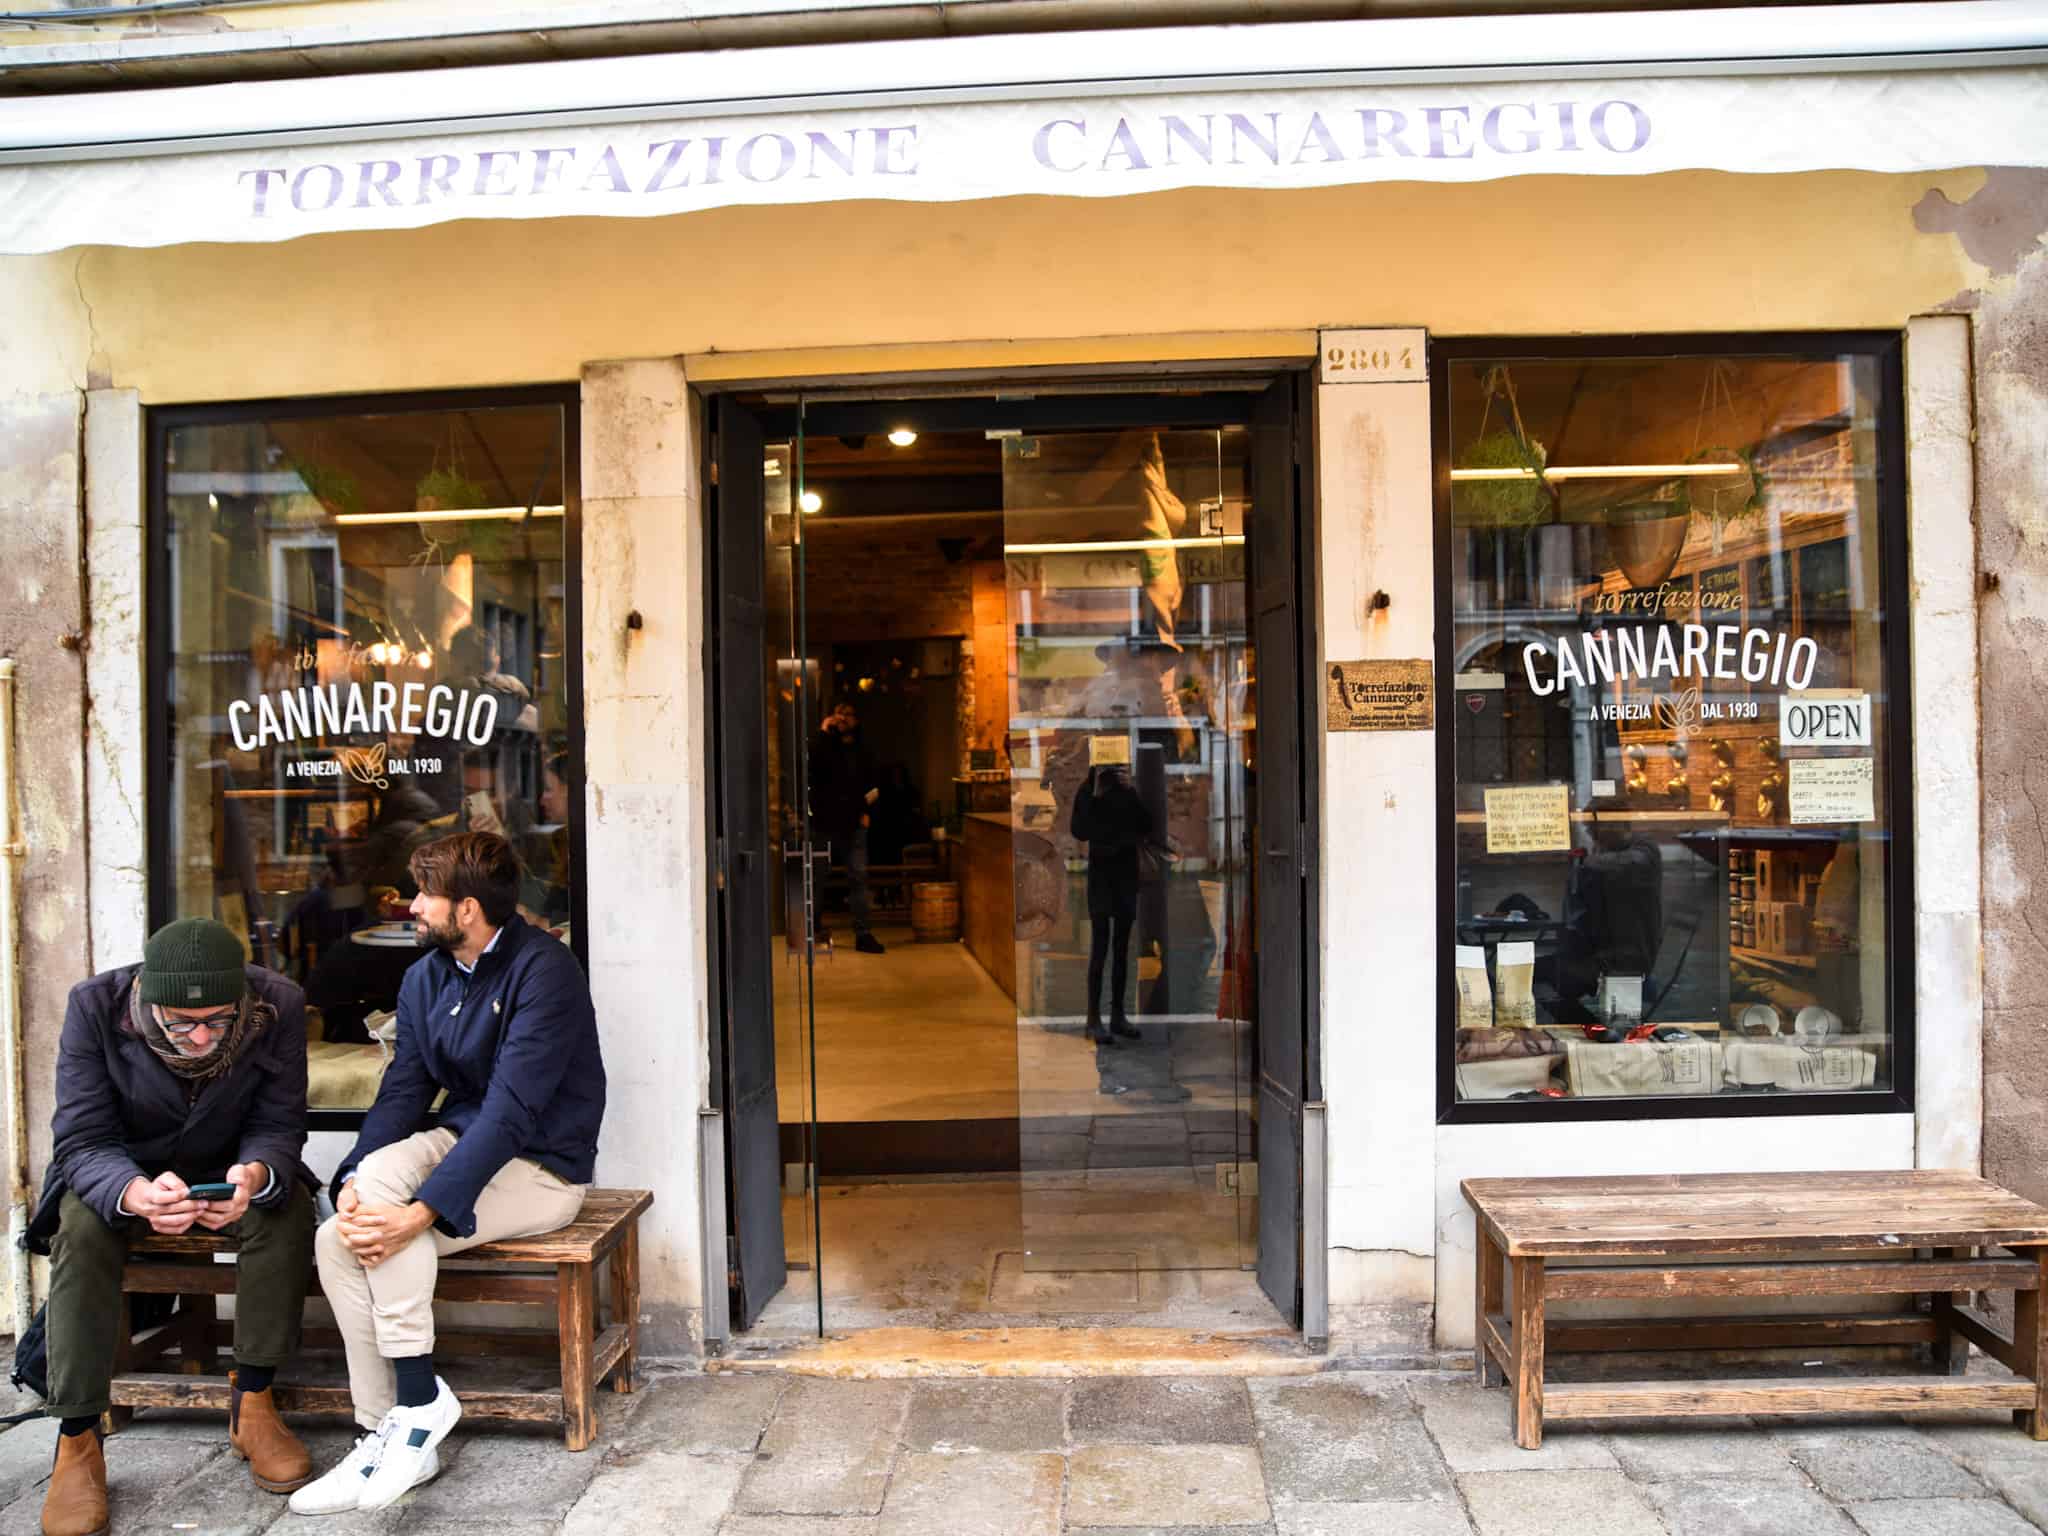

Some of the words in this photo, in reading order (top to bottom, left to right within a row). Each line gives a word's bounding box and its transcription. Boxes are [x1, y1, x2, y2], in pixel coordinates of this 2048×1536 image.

[238, 124, 918, 219] TORREFAZIONE
[1031, 100, 1652, 171] CANNAREGIO
[1327, 348, 1412, 371] 2804
[1594, 582, 1744, 617] torrefazione
[1522, 624, 1818, 696] CANNAREGIO
[1349, 681, 1428, 693] Torrefazione
[1353, 691, 1425, 705] Cannaregio
[227, 681, 499, 752] CANNAREGIO
[1590, 705, 1599, 720] A
[1601, 706, 1651, 720] VENEZIA
[1700, 704, 1725, 719] DAL
[1727, 702, 1758, 718] 1930
[1788, 704, 1861, 738] OPEN
[286, 762, 295, 777] A
[297, 760, 342, 777] VENEZIA
[388, 758, 411, 775] DAL
[414, 758, 442, 774] 1930
